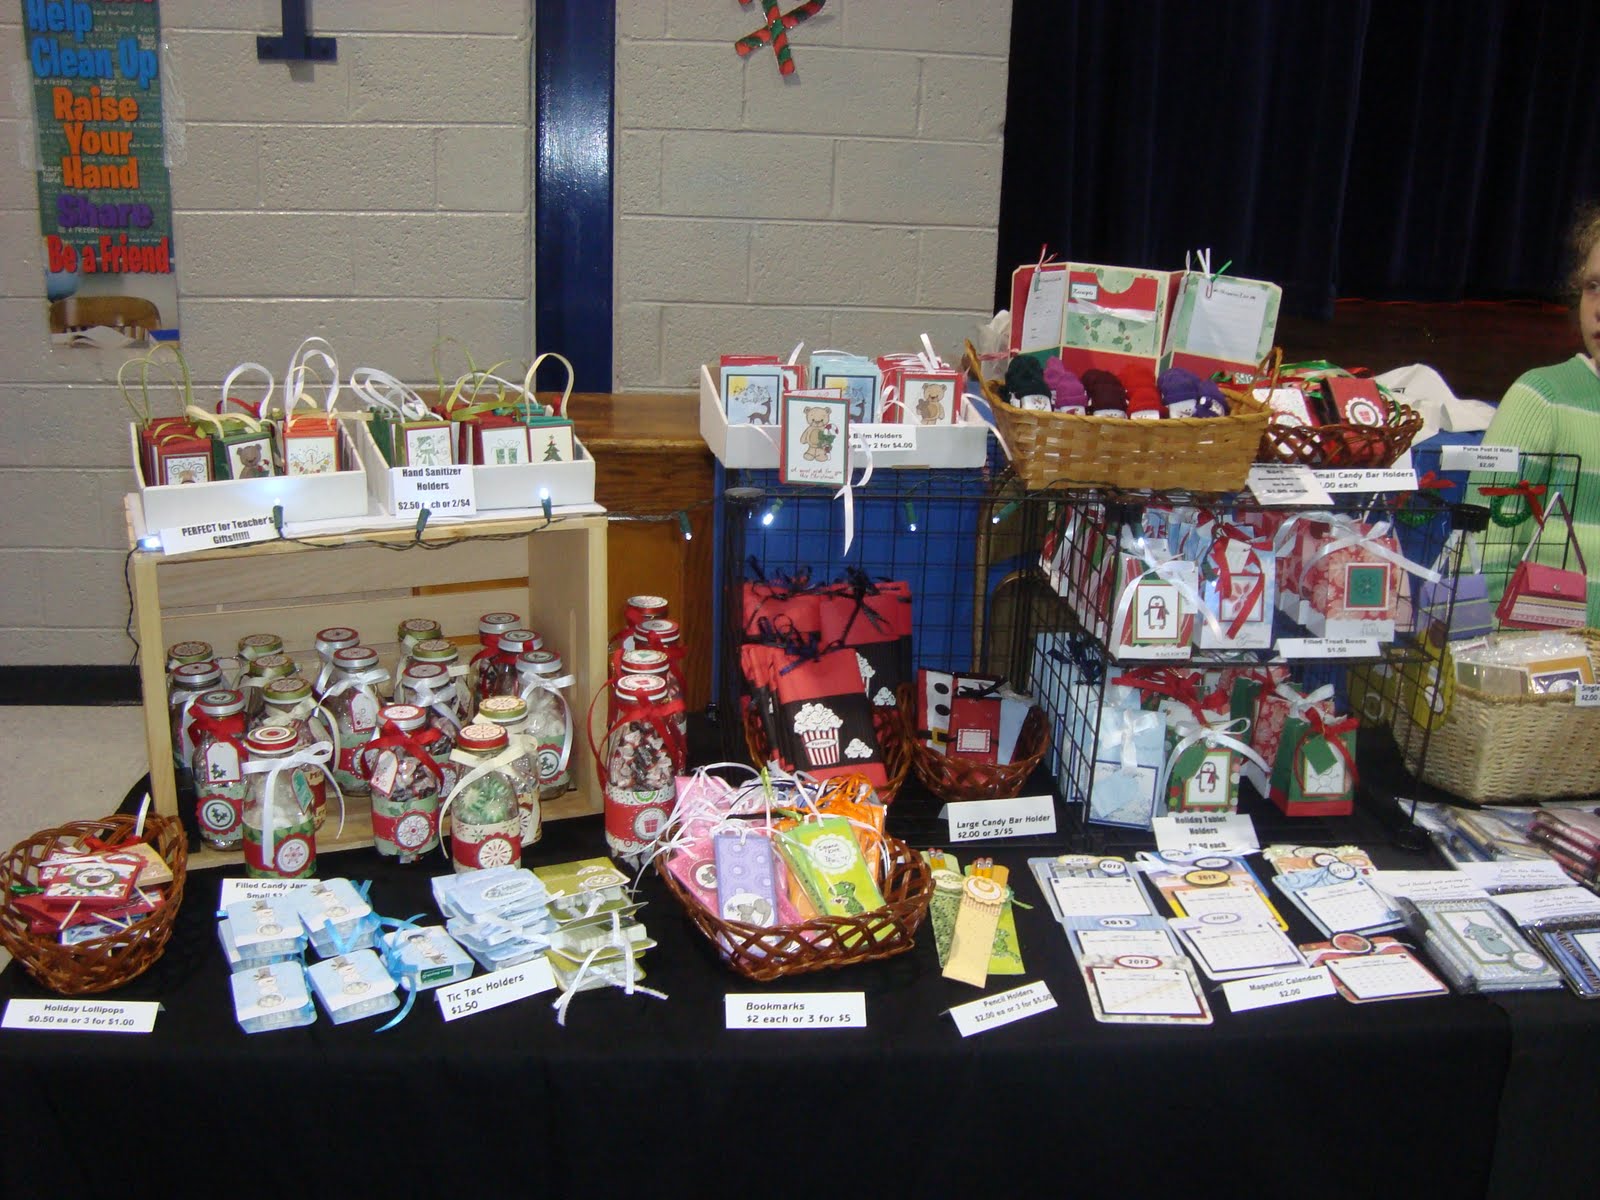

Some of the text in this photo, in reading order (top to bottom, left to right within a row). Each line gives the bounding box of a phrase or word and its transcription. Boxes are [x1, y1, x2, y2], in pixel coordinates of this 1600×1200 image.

[28, 0, 93, 44] Help
[31, 37, 158, 90] Clean Up
[53, 86, 139, 122] Raise
[64, 122, 133, 155] Your
[62, 155, 139, 189] Hand
[57, 193, 154, 229] Share
[47, 233, 170, 274] Be a Friend
[402, 467, 462, 478] Hand Sanitizer
[1313, 471, 1336, 479] Small
[1338, 471, 1363, 480] Candy
[1365, 471, 1380, 479] Bar
[417, 481, 450, 491] Holders
[398, 501, 420, 510] $2.50
[181, 515, 275, 537] PERFECT for Teacher's
[956, 814, 1051, 830] Large Candy Bar Holder
[958, 830, 980, 839] $2.00
[994, 827, 1014, 836] 3/$5
[1188, 827, 1218, 835] Holders
[1102, 862, 1122, 870] 2012
[261, 882, 288, 890] Candy
[446, 973, 525, 1003] Tic Tac Holders
[1249, 974, 1323, 991] Magnetic Calendars
[983, 988, 1034, 1007] Pencil Holders
[1279, 988, 1301, 998] $2.00
[44, 1004, 125, 1015] Holiday Lollipops
[451, 1000, 479, 1015] $1.50
[746, 1001, 806, 1011] Bookmarks
[975, 1011, 995, 1023] $2.00
[1021, 1000, 1032, 1008] for
[28, 1015, 55, 1023] $0.50
[92, 1017, 105, 1025] for
[108, 1018, 135, 1026] $1.00
[747, 1014, 759, 1023] $2
[763, 1014, 788, 1023] each
[808, 1014, 815, 1023] 3
[819, 1014, 835, 1023] for
[839, 1013, 851, 1023] $5
